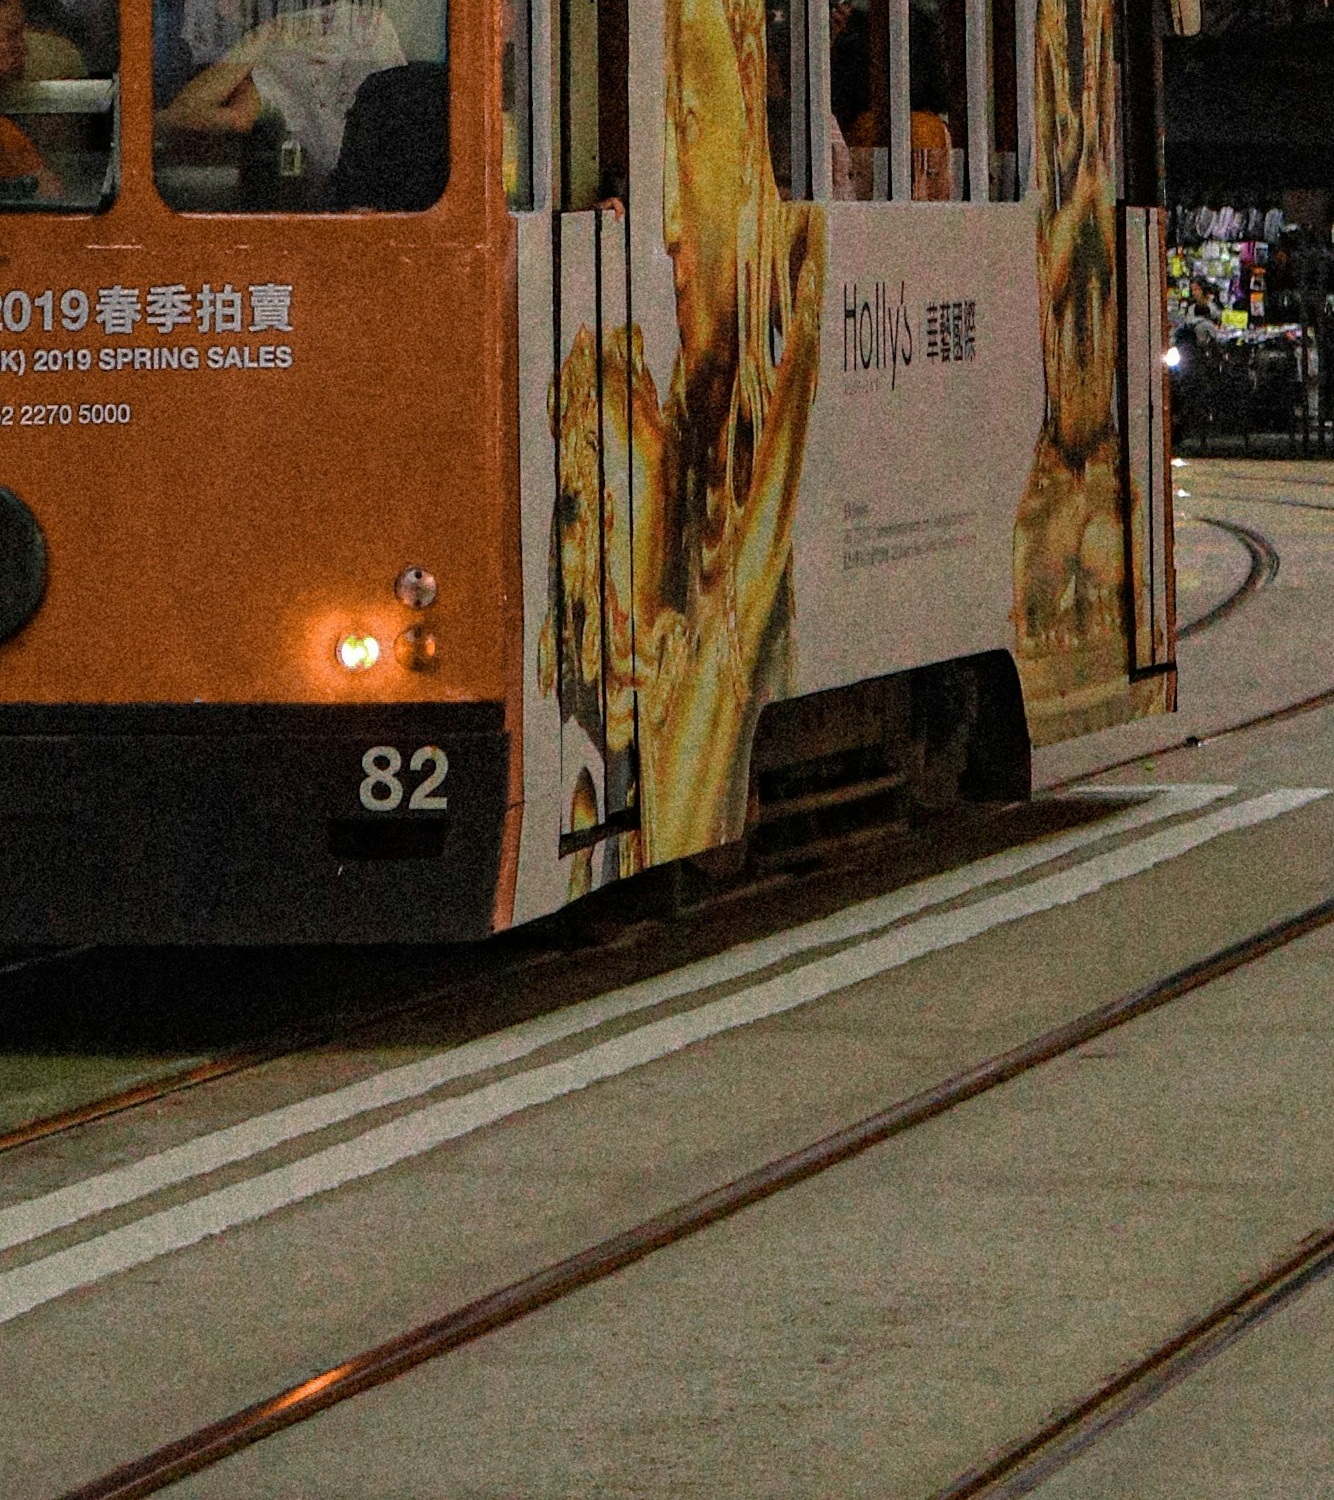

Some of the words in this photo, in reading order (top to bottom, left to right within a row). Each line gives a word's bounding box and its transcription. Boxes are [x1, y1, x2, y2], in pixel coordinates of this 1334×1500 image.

[32, 347, 93, 374] 2019
[97, 345, 200, 373] SPRING
[205, 342, 294, 372] SALES
[843, 280, 913, 391] Holly's
[19, 402, 73, 428] 2270
[76, 401, 132, 427] 5000
[358, 745, 451, 813] 82
